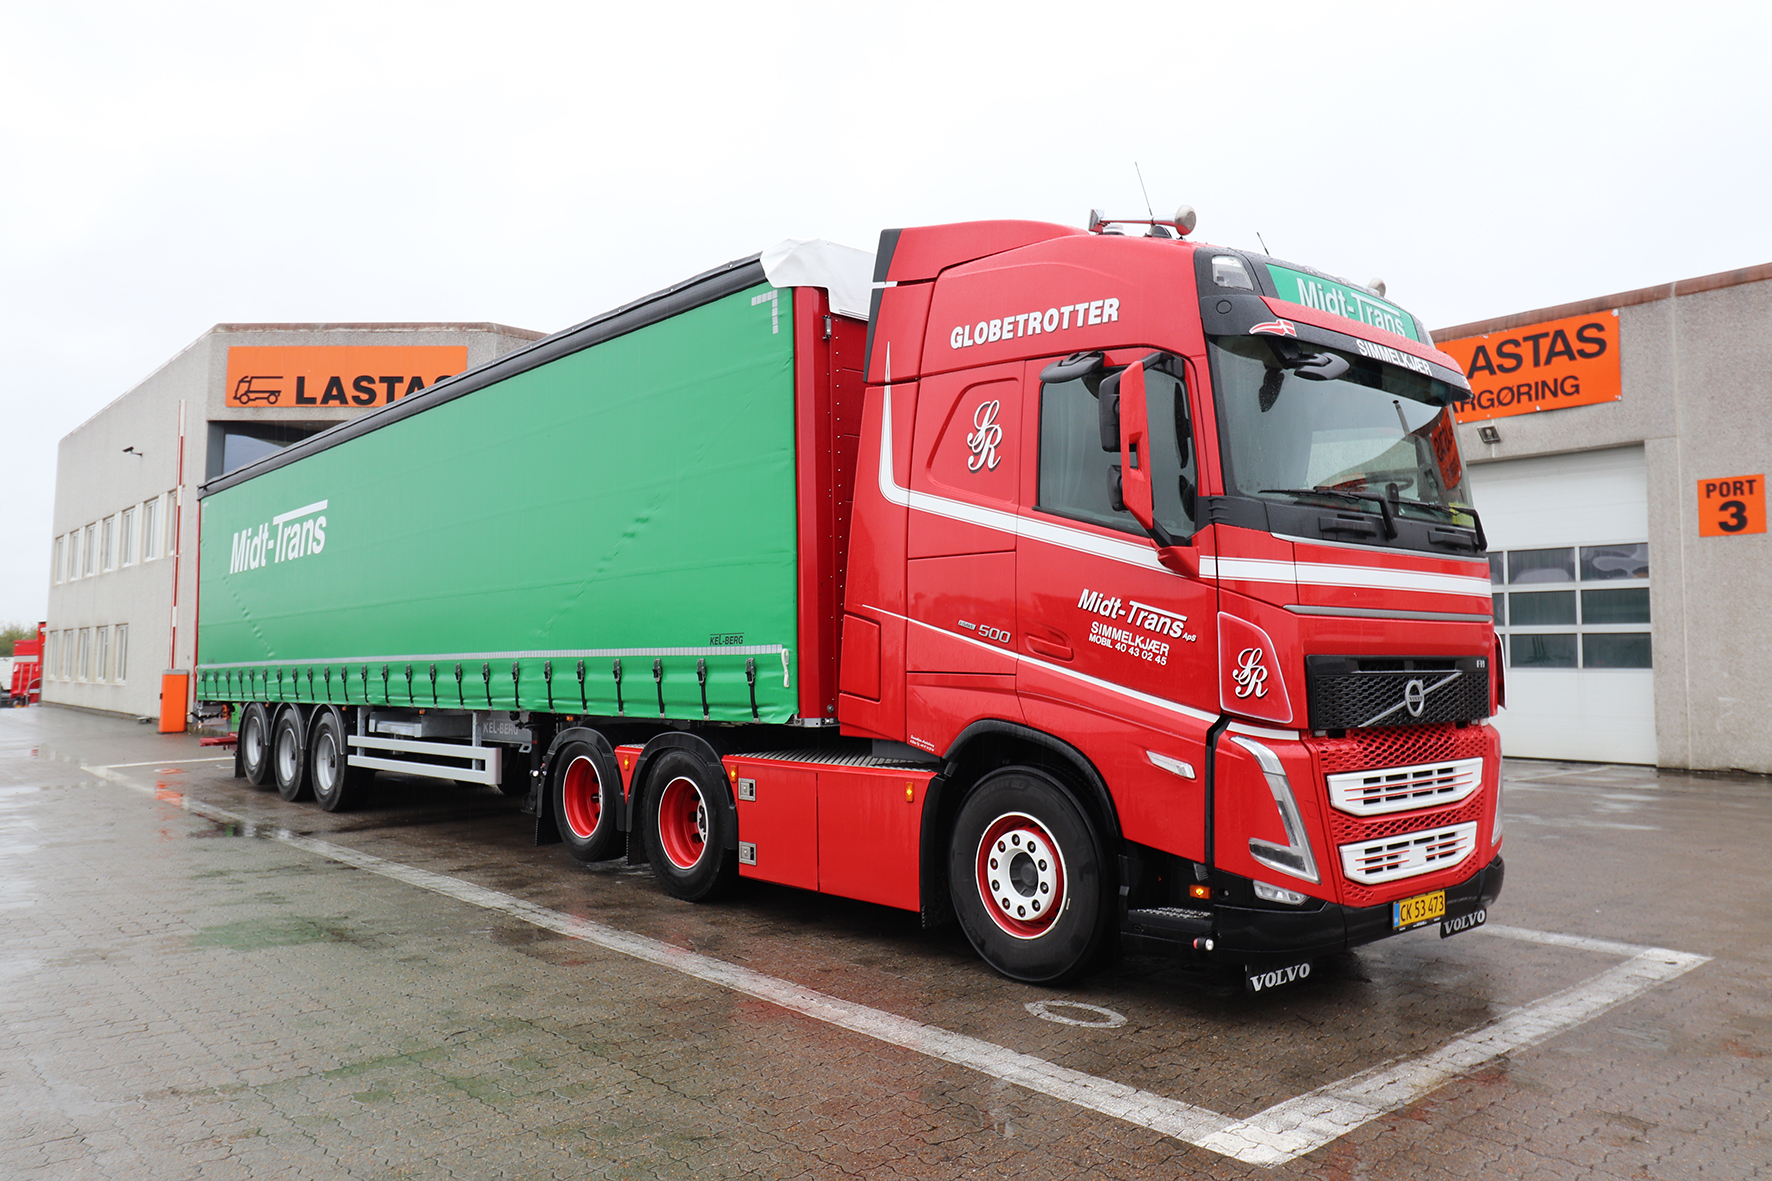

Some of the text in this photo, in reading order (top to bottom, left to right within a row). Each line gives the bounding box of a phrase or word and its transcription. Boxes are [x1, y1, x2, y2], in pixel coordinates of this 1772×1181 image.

[950, 297, 1120, 350] GLOBETROTTER
[1296, 277, 1406, 337] Midt-Trans
[1355, 338, 1433, 377] SIMMELKJÆR
[1443, 322, 1607, 380] ASTAS
[295, 375, 454, 406] LASTA
[1705, 479, 1757, 499] PORT
[1718, 500, 1748, 533] 3
[229, 499, 328, 575] Midt-Trans
[1077, 588, 1197, 643] Midt-Trans ApS
[709, 632, 745, 646] KEL-BERG
[978, 624, 1012, 644] 500
[1088, 633, 1168, 666] MOBIL 40 43 02 45
[1090, 621, 1170, 656] SIMMELKJÆR
[1400, 895, 1445, 922] CK 53 473
[1443, 909, 1486, 935] VOLVO
[1249, 962, 1310, 992] VOLVO
